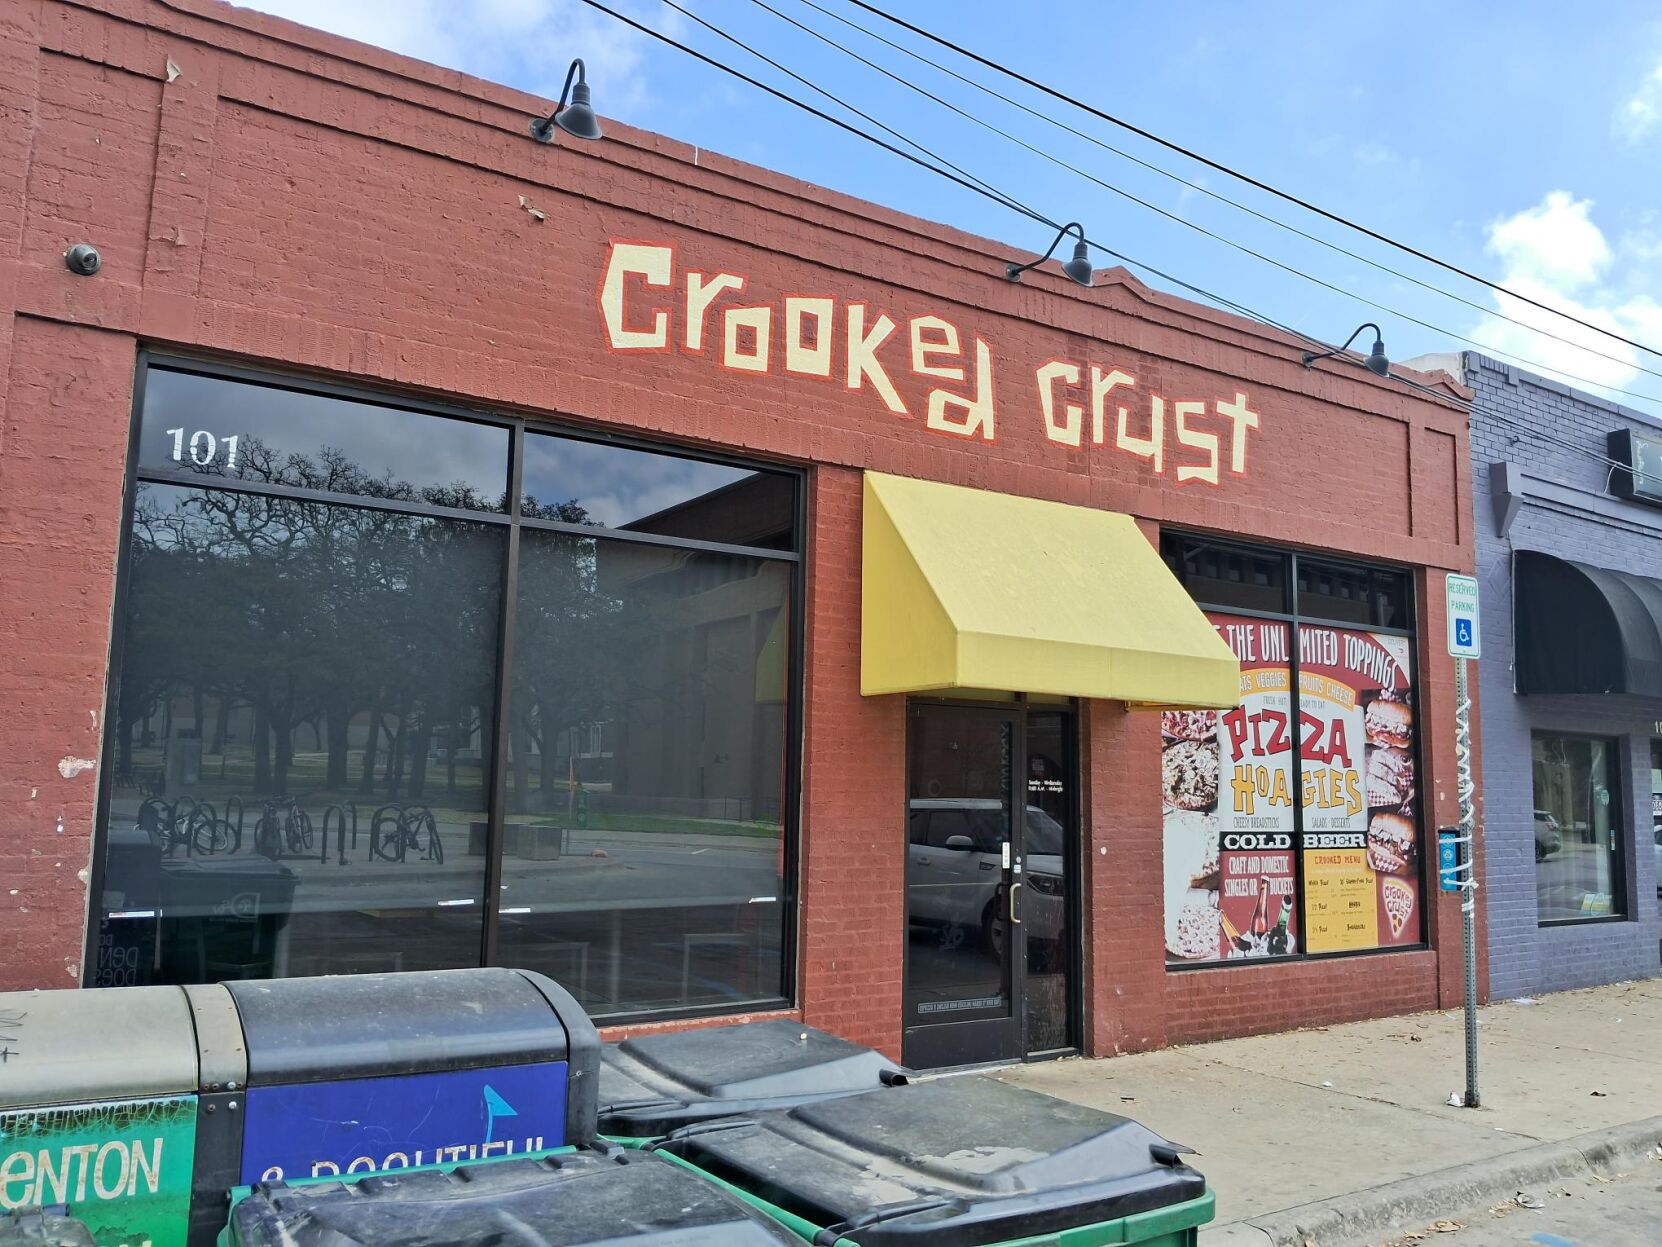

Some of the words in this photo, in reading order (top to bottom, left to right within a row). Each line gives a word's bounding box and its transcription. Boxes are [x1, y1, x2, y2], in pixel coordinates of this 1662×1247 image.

[166, 427, 239, 469] 101
[1448, 583, 1477, 597] RESERVED
[1451, 600, 1475, 613] PARKING
[1227, 624, 1256, 662] THE
[1260, 624, 1338, 667] UNLMITED
[1343, 633, 1398, 692] TOPPINGS
[1240, 674, 1252, 691] ATS
[1255, 671, 1287, 689] VEGGIES
[1327, 682, 1354, 707] CHEESE
[1222, 704, 1352, 768] PIZZA
[1231, 764, 1362, 817] HOAGIES
[1223, 833, 1292, 850] COLD
[1303, 833, 1367, 848] BEER
[1229, 856, 1247, 875] CRAFT
[1247, 856, 1260, 874] AND
[1261, 855, 1289, 874] DOMESTIC
[1344, 855, 1361, 864] MENU
[1224, 878, 1249, 897] SINGLES
[1249, 878, 1258, 896] OR
[1270, 877, 1294, 895] BUCKETS
